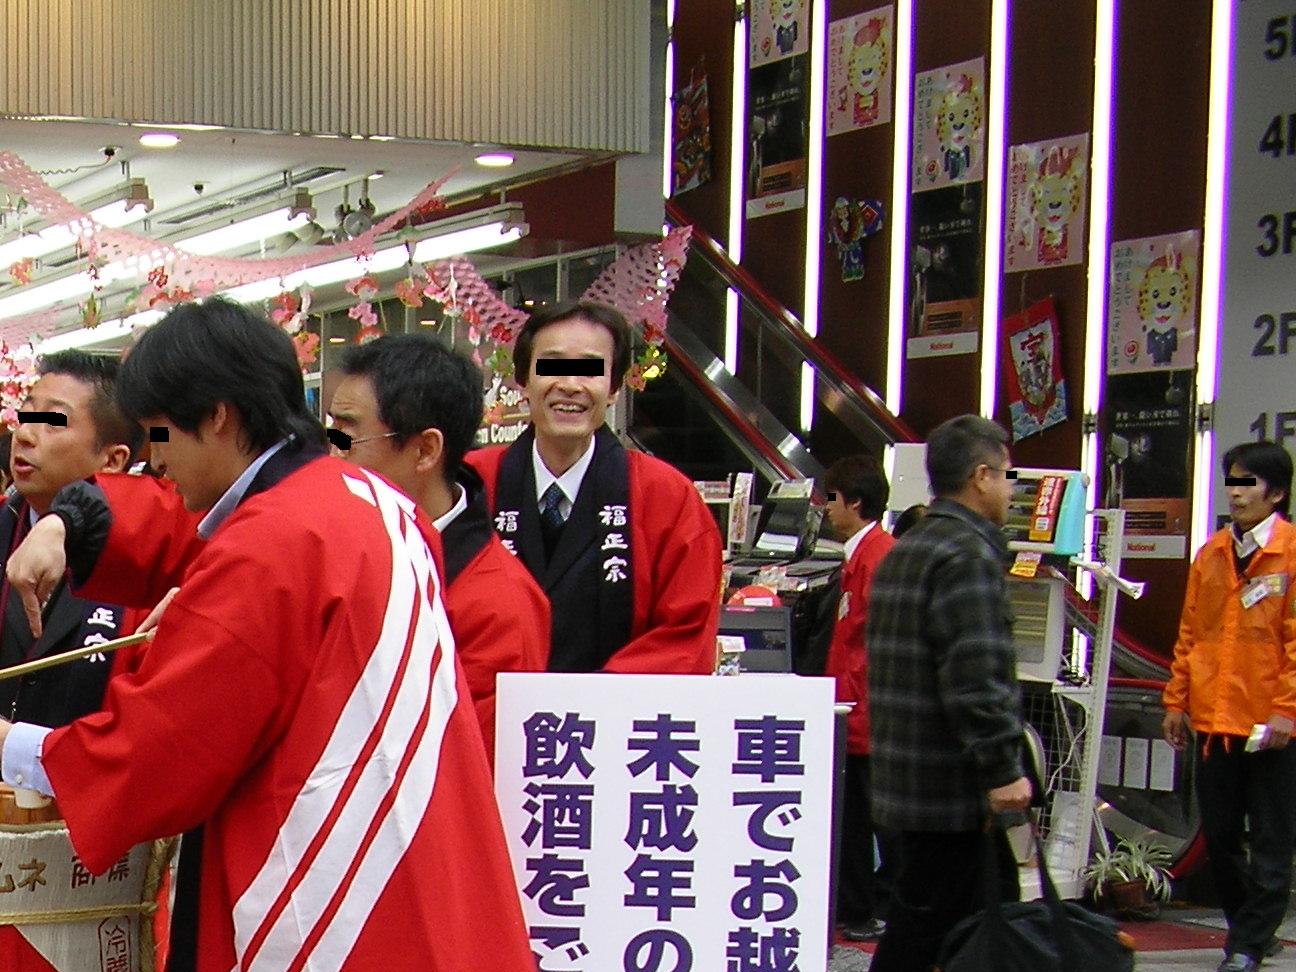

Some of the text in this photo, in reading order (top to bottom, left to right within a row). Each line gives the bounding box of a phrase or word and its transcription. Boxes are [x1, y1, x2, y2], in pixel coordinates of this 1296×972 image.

[1264, 16, 1296, 62] 5
[599, 506, 629, 583] 福正宗
[1127, 543, 1156, 552] National
